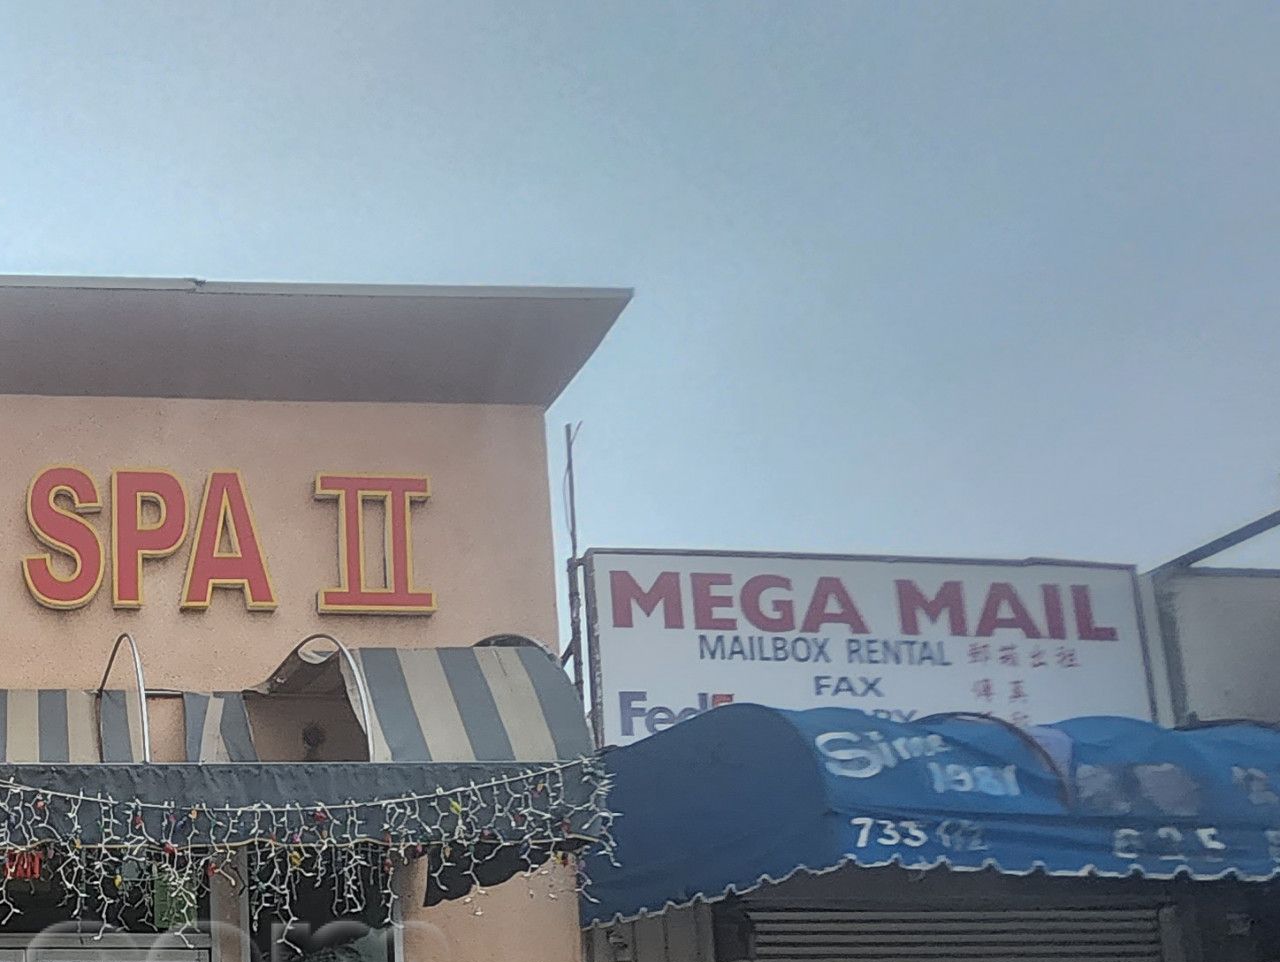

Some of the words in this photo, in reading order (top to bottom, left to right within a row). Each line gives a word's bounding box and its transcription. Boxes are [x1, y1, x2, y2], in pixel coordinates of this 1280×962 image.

[21, 466, 277, 610] SPA
[315, 472, 436, 614] II
[609, 570, 870, 635] MEGA
[894, 578, 1118, 641] MAIL
[698, 634, 832, 664] MAILBOX
[847, 638, 952, 666] RENTAL
[814, 675, 883, 698] FAX
